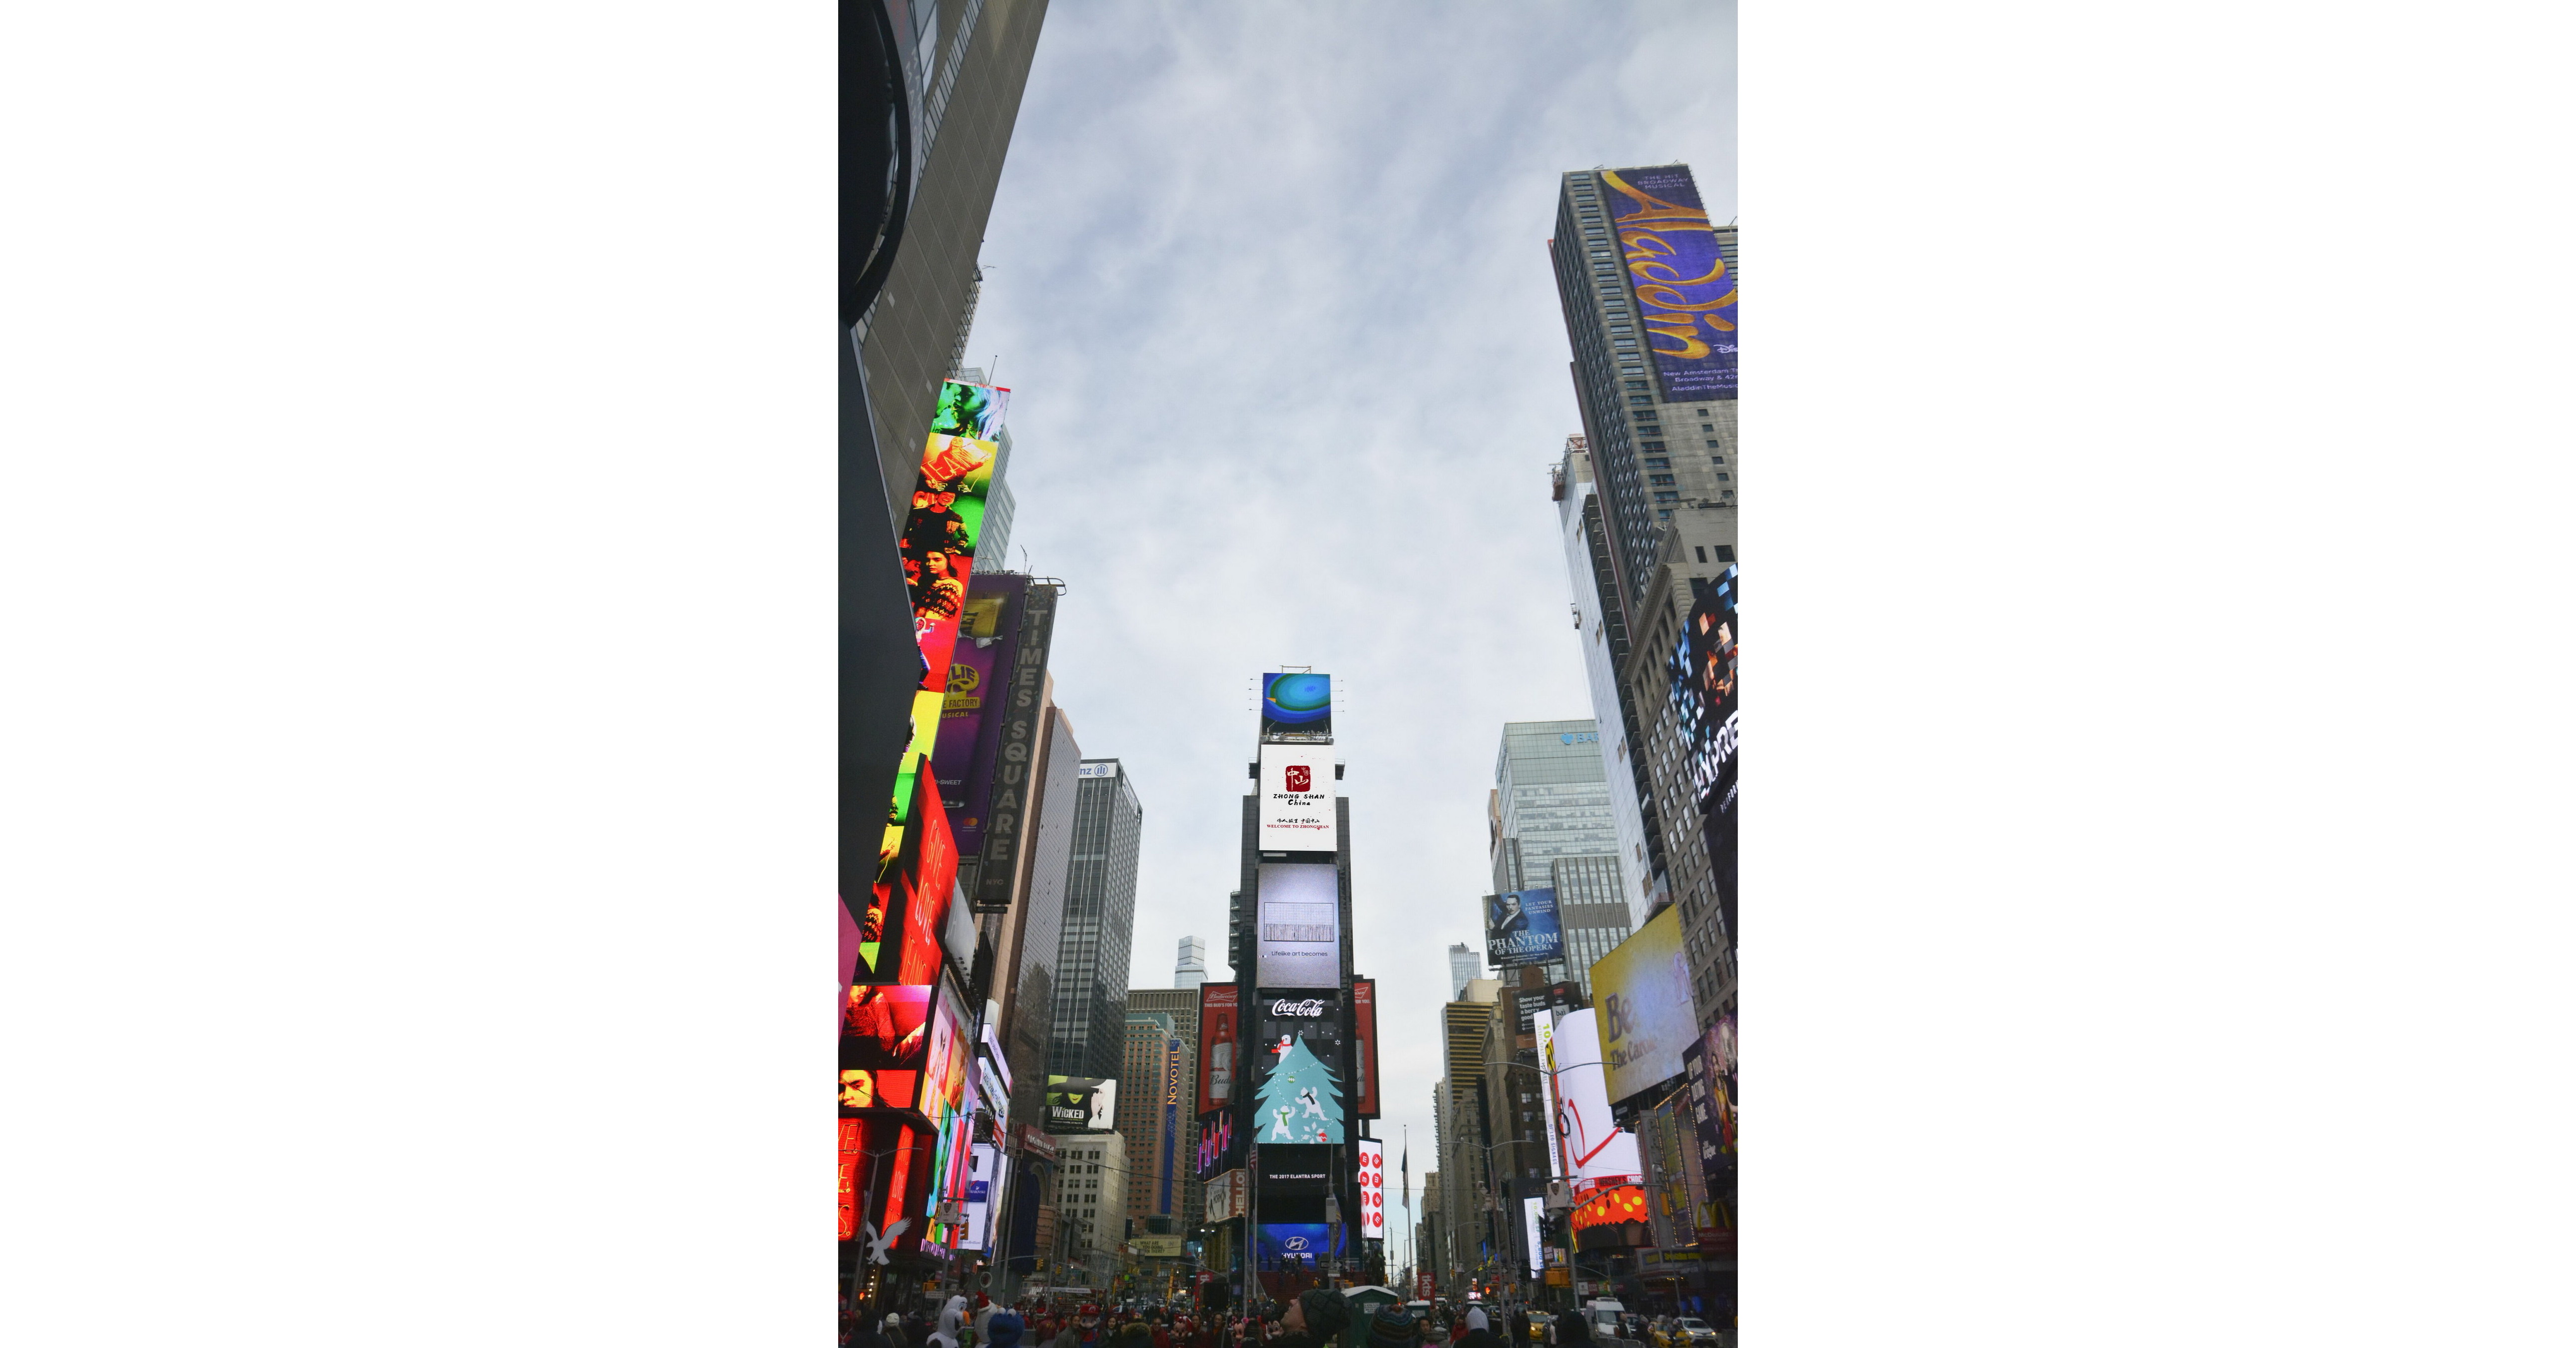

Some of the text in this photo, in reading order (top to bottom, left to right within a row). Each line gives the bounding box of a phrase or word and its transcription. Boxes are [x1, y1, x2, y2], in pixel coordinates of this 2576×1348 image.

[1017, 610, 1048, 707] TIMES
[949, 665, 976, 683] LIE
[949, 698, 978, 708] FACTORY
[991, 721, 1028, 860] SQUARE
[1488, 932, 1558, 950] PHANTOM
[1272, 999, 1325, 1017] Coca-Cola
[1167, 1046, 1180, 1105] NOVOTEL
[1599, 1176, 1626, 1187] HERSHEY'S
[1421, 1274, 1432, 1297] tkts
